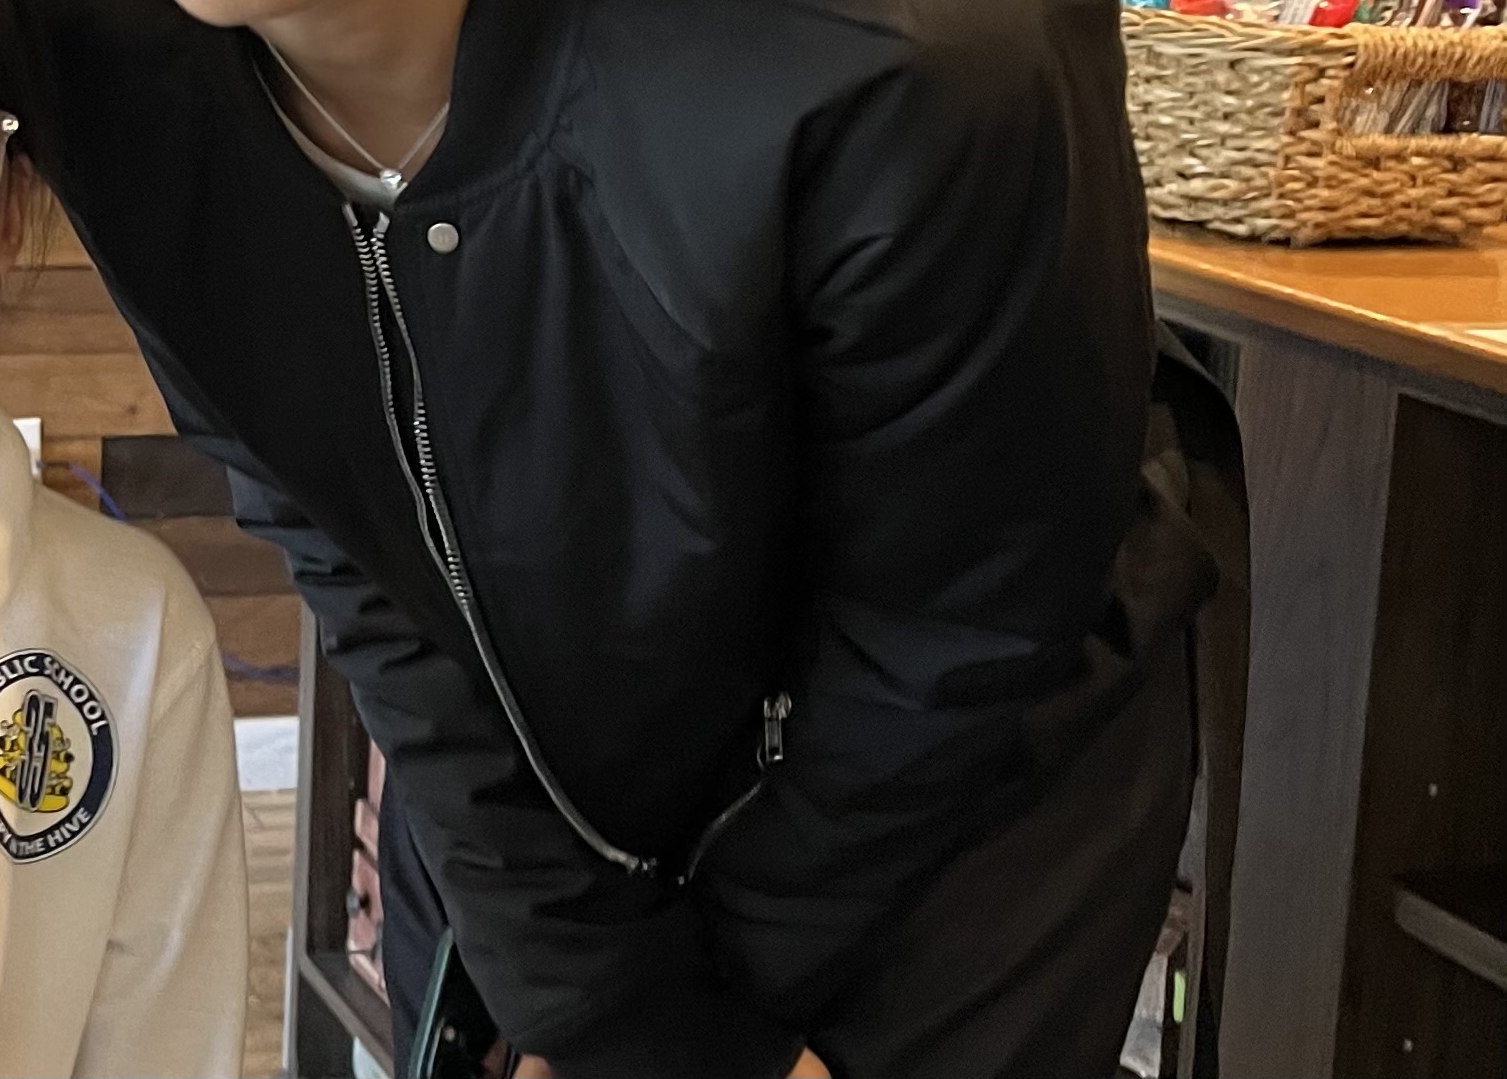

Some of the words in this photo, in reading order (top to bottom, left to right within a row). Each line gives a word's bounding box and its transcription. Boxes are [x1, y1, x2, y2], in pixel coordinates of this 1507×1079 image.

[43, 656, 110, 736] SCHOOL
[16, 837, 46, 856] THE
[46, 806, 92, 848] HIVE
